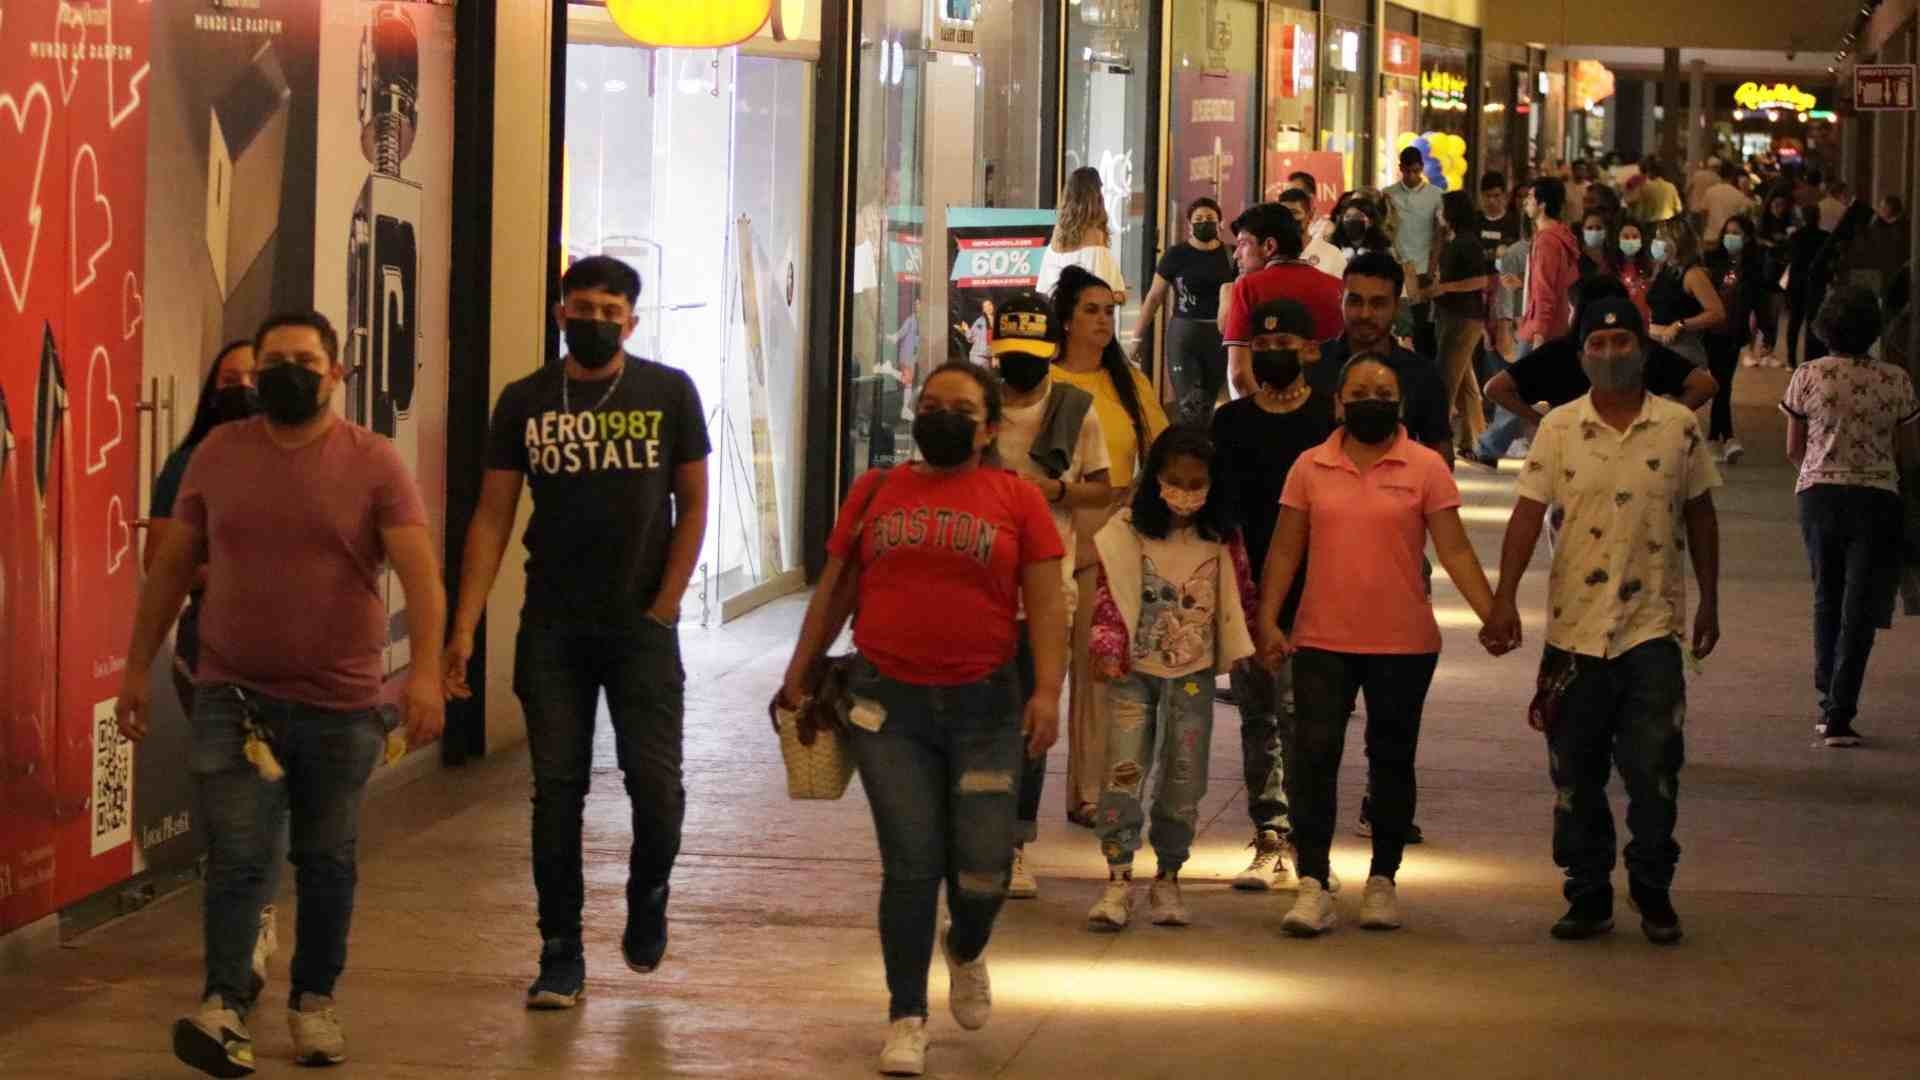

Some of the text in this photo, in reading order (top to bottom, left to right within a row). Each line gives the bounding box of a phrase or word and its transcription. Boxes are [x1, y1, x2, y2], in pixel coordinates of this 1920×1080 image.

[971, 250, 1031, 275] 60%
[527, 439, 661, 475] POSTALE
[873, 507, 998, 568] BOSTON
